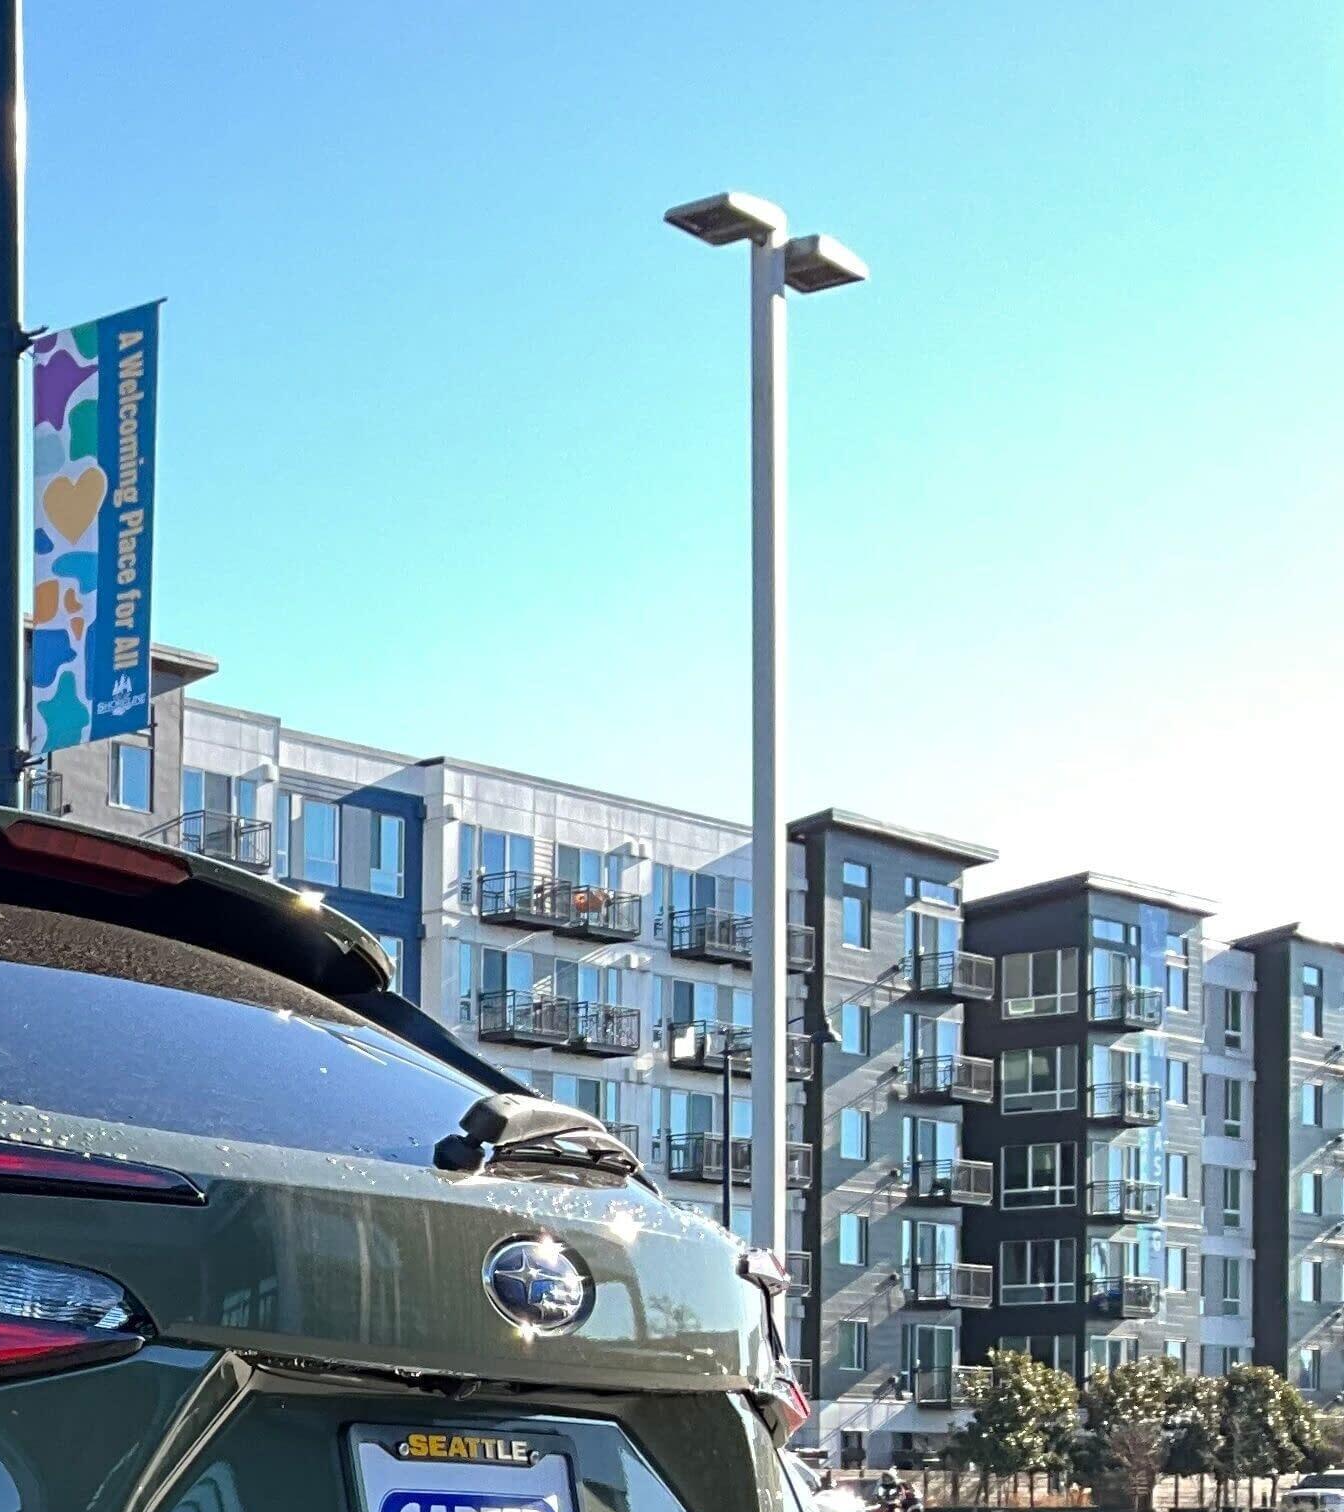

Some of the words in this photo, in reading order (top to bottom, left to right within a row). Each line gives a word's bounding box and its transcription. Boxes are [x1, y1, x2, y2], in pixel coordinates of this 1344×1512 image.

[119, 330, 144, 350] A
[113, 351, 145, 508] Welcoming
[116, 509, 144, 584] Place
[114, 589, 141, 629] for
[113, 637, 141, 671] All
[408, 1432, 529, 1462] SEATTLE
